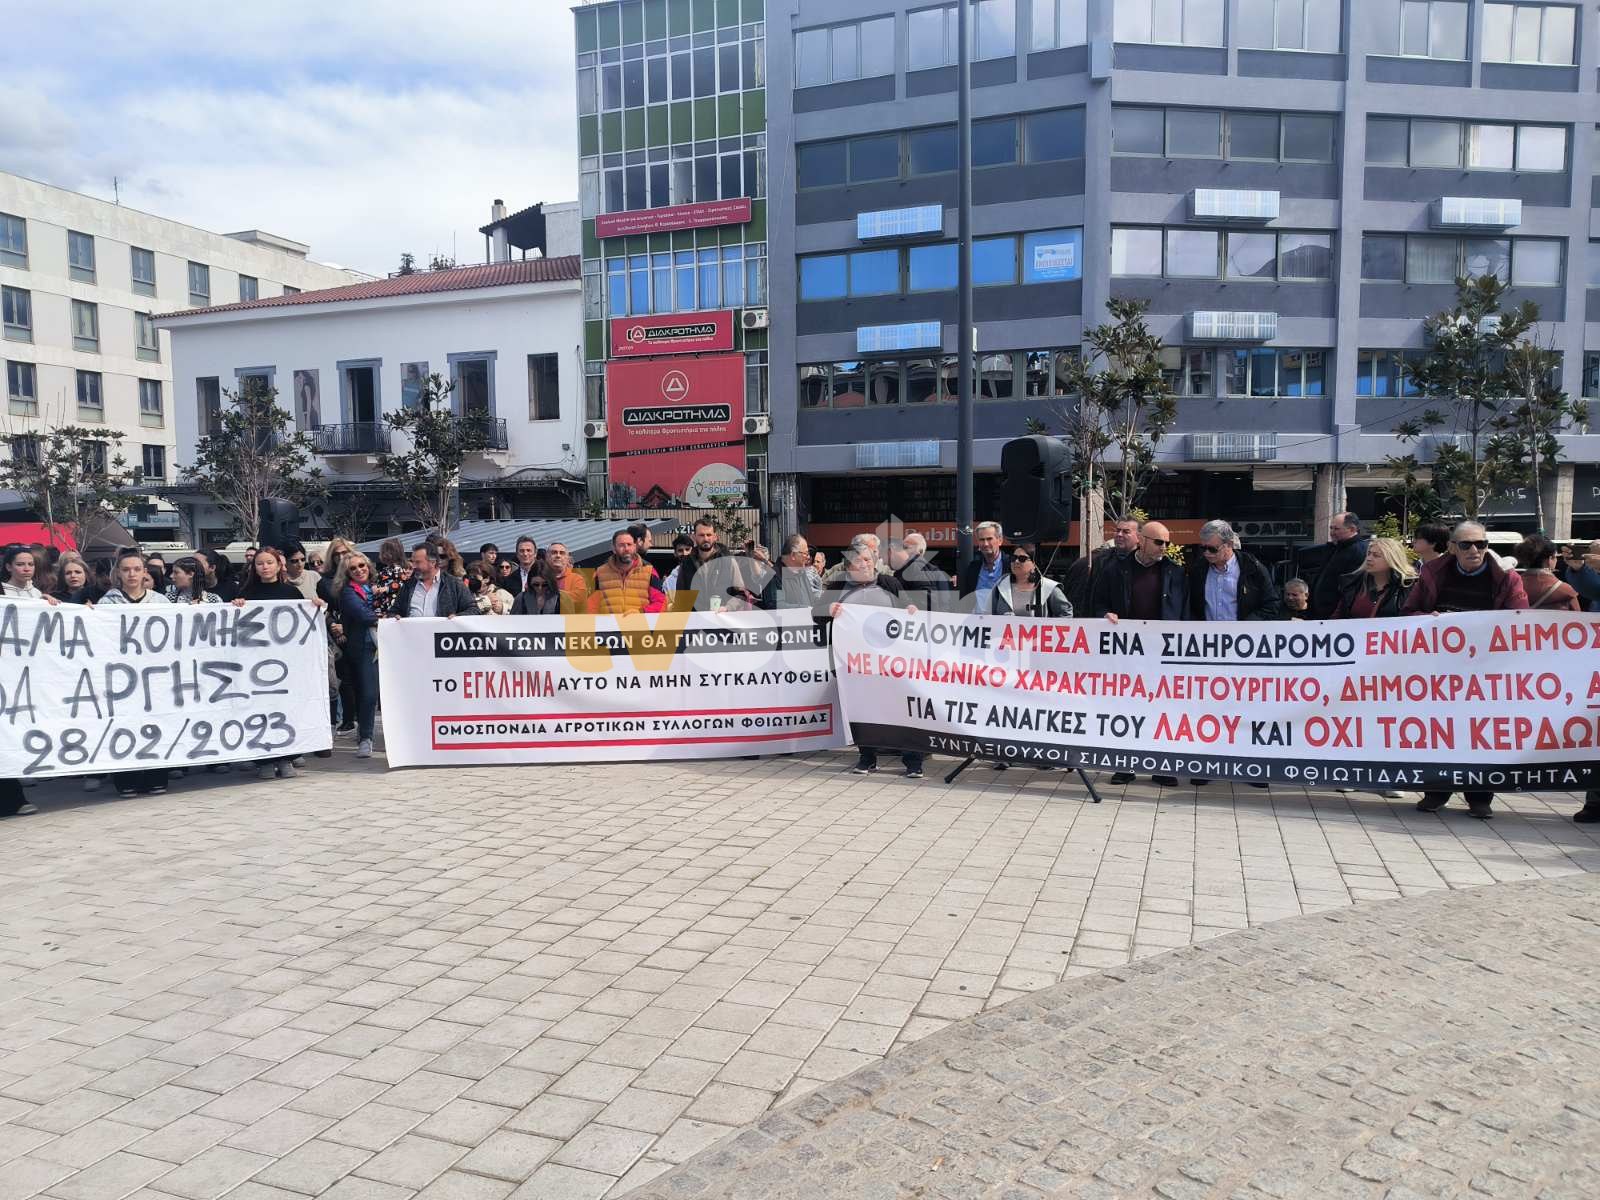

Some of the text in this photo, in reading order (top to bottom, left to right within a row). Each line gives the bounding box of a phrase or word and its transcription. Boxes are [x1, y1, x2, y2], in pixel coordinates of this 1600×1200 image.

[627, 409, 727, 422] ΔΙΑΚΡΟΤΗΜΑ
[709, 486, 741, 494] SCHOOL
[440, 629, 822, 651] ΟΛΩΝ ΤΩΝ ΝΕΚΡΩΝ ΘΑ ΓΙΝΟΥΜΕ ΦΩΝΗ
[886, 619, 992, 650] ΘΕΛΟΥΜΕ
[998, 623, 1090, 655] ΑΜΕΣΑ
[1099, 631, 1145, 656] ΕΝΑ
[1161, 632, 1355, 659] ΣΙΔΗΡΟΔΡΟΜΟ
[1365, 626, 1476, 659] ΕΝΙΑΙΟ,
[433, 679, 457, 693] ΤΟ
[463, 670, 555, 698] ΕΓΚΛΗΜΑ
[557, 675, 608, 692] ΑΥΤΟ
[616, 675, 642, 689] ΝΑ
[650, 673, 691, 688] ΜΗΝ
[847, 652, 872, 675] ΜΕ
[878, 654, 1008, 688] ΚΟΙΝΩΝΙΚΟ
[1340, 672, 1574, 706] ΔΗΜΟΚΡΑΤΙΚΟ,
[437, 712, 828, 736] ΟΜΟΣΠΟΝΔΙΑ ΑΓΡΟΤΙΚΩΝ ΣΥΛΛΟΓΩΝ ΦΘΙΩΤΙΔΑΣ
[906, 696, 1600, 751] ΓΙΑ ΤΙΣ ΑΝΑΓΚΕΣ ΤΟΥ ΛΑΟΥ ΚΑΙ ΟΧΙ ΤΩΝ ΚΕΡΔΩ
[22, 711, 296, 776] 28/02/2023
[928, 735, 1069, 761] ΣΥΝΤΑΞΙΟΥΧΟΙ
[1079, 751, 1270, 778] ΣΙΔΗΡΟΔΡΟΜΙΚΟΙ
[1284, 765, 1425, 785] ΦΘΙΩΤΙΔΑΣ
